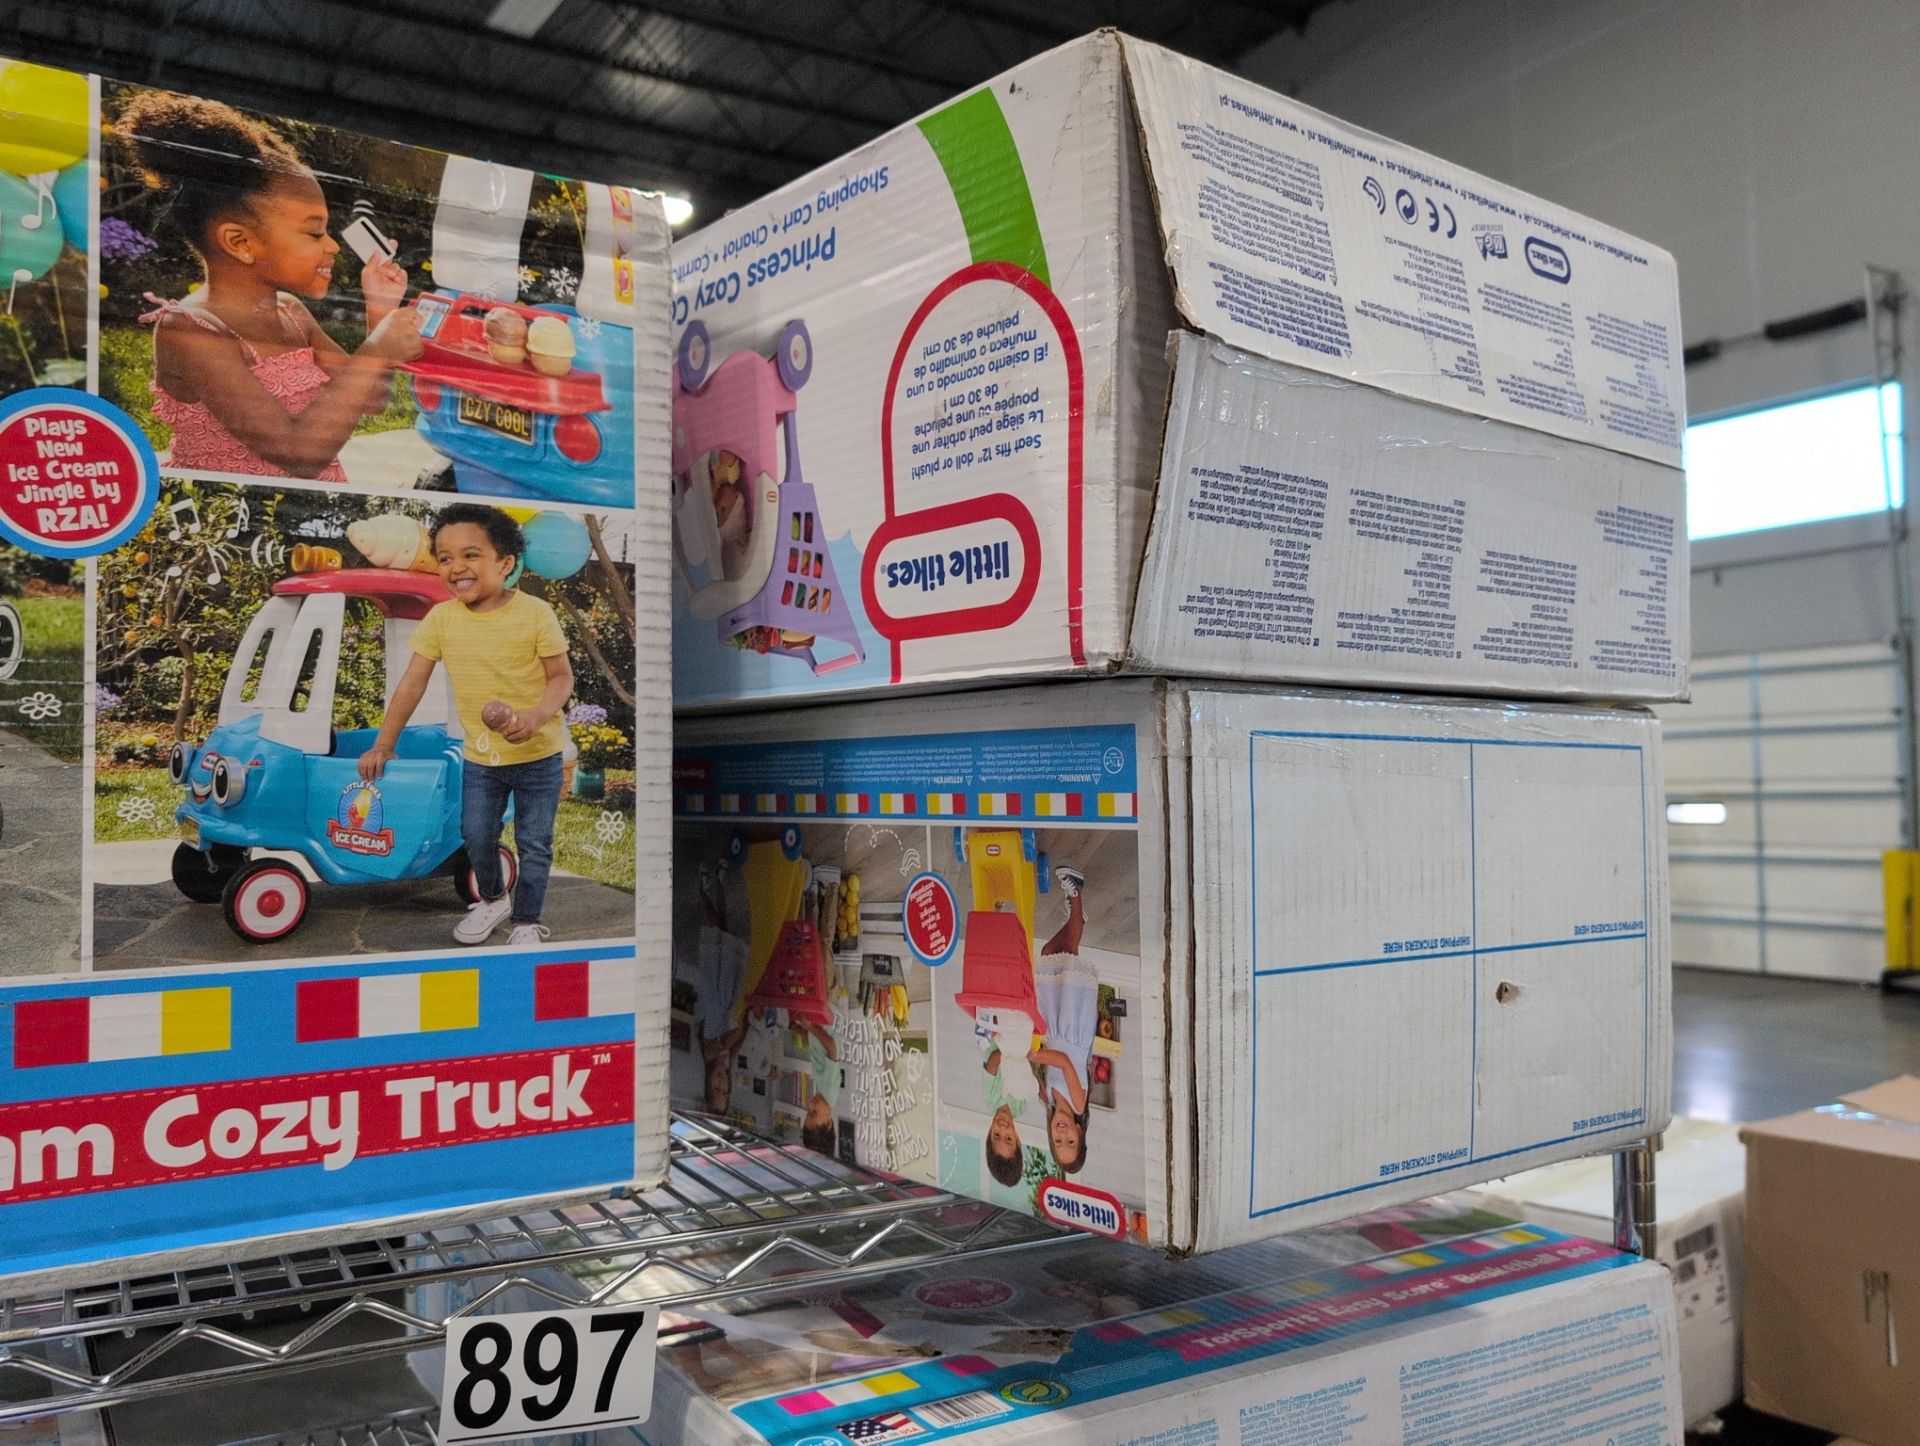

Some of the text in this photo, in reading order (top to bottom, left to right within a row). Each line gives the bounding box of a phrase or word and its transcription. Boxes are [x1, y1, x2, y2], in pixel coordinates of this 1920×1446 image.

[1219, 95, 1297, 136] www.littletikes.pl
[1307, 129, 1377, 164] www.littletikes.nl
[1386, 160, 1452, 189] www.littletikes.es
[817, 166, 889, 213] Shopping
[783, 204, 812, 234] Cart
[724, 224, 767, 262] Chariot
[747, 226, 836, 287] Princess
[695, 272, 740, 310] Cozy
[923, 310, 1018, 360] peluche de 30 cm!
[913, 327, 1036, 381] muñeca o animalito de
[906, 341, 1047, 398] ¡El asiento acomoda a una
[949, 393, 964, 408] cm
[968, 388, 981, 404] 30
[984, 382, 998, 400] de
[994, 386, 1038, 416] poupée
[25, 417, 87, 441] Plays
[466, 398, 528, 436] CZY COOL
[914, 411, 952, 439] peluche
[955, 409, 974, 424] une
[969, 418, 992, 441] peut
[995, 409, 1024, 435] siège
[1028, 408, 1043, 425] Le
[36, 440, 83, 458] New
[911, 433, 1041, 480] Seat fits 12" doll or plush!
[912, 440, 929, 454] une
[8, 460, 119, 482] Ice Cream
[16, 479, 121, 506] Jingle by
[37, 504, 109, 533] RZA!
[948, 539, 1009, 586] little
[344, 781, 364, 794] LITTLE
[1058, 774, 1091, 782] WARNING:
[336, 831, 386, 850] ICE CREAM
[1574, 921, 1643, 935] SHIPPING STICKERS HERE
[1383, 936, 1470, 953] SHIPPING STICKERS HERE
[144, 1091, 360, 1170] Cozy
[888, 1118, 911, 1144] THE
[1573, 1108, 1642, 1131] SHIPPING STICKERS HERE
[864, 1135, 928, 1172] DON'T FORGET
[1379, 1148, 1467, 1176] SHIPPING STICKERS HERE
[1048, 1194, 1115, 1230] little tikes
[1321, 1292, 1385, 1319] Easy
[1450, 1250, 1555, 1286] Basketball
[453, 1311, 644, 1429] 897
[860, 1434, 888, 1445] MADE
[900, 1426, 919, 1436] USA
